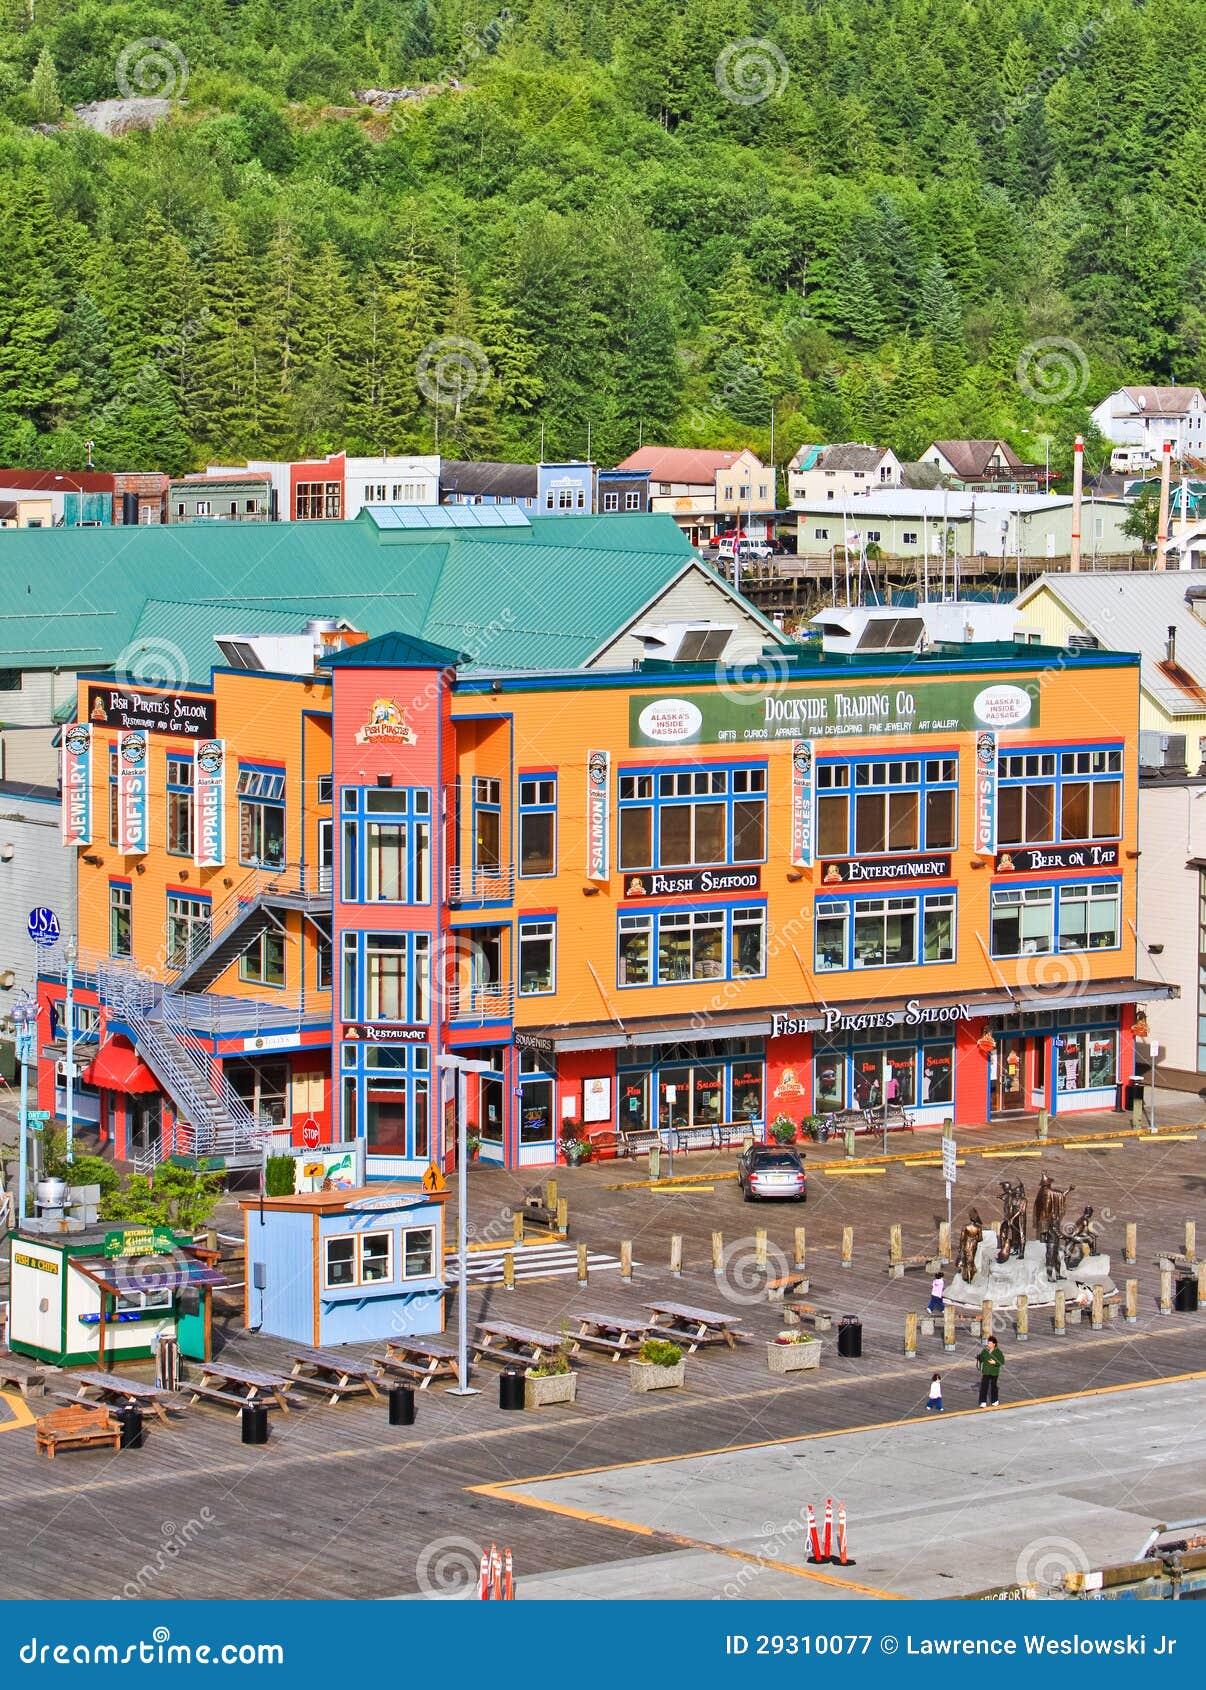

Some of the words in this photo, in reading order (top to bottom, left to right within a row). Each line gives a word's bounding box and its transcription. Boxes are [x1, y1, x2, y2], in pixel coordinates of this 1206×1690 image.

[110, 692, 128, 710] FISH
[131, 694, 170, 714] PIRATE'S
[174, 699, 207, 720] SALOON
[765, 697, 828, 721] DOCKSIDE
[835, 692, 889, 718] TRADING
[896, 690, 916, 715] CO.
[121, 713, 155, 729] RESTAURANT
[170, 718, 182, 731] GIFT
[185, 722, 199, 734] SHOP
[651, 713, 690, 721] ALASKA'S
[364, 724, 380, 737] FISH
[718, 730, 737, 739] GIFTS
[743, 729, 768, 738] CURIOS
[775, 727, 802, 736] APPAREL
[809, 726, 823, 735] FILM
[825, 724, 862, 734] DEVELOPING
[869, 723, 882, 732] FINE
[884, 721, 912, 731] JEWELRY
[918, 720, 930, 729] ART
[932, 719, 959, 729] GALLERY
[121, 768, 146, 776] Alaskan
[198, 778, 222, 786] Alaskan
[70, 761, 86, 836] JEWELRY
[589, 790, 606, 798] Smoked
[126, 778, 142, 844] GIFTS
[794, 795, 803, 848] TOTEM
[980, 780, 992, 843] GIFTS
[203, 787, 218, 857] APPAREL
[803, 799, 811, 849] POLES
[592, 801, 603, 869] SALMON
[1027, 851, 1067, 869] BEER
[1069, 852, 1085, 866] ON
[1091, 846, 1115, 865] TAP
[848, 862, 946, 880] ENTERTAINMENT
[650, 874, 693, 895] FRESH
[701, 871, 757, 891] SEAFOOD
[29, 907, 60, 934] USA
[771, 1012, 808, 1039] FISH
[821, 1008, 896, 1033] PIRATES
[905, 1000, 972, 1025] SALOON
[363, 1026, 426, 1041] RESTAURANT
[515, 1033, 552, 1050] SOUVENIRS
[926, 1057, 951, 1067] SALOON
[696, 1079, 722, 1091] SALOON
[303, 1127, 319, 1141] STOP
[15, 1253, 30, 1267] FISH
[31, 1258, 37, 1268] &
[37, 1260, 58, 1274] CHIPS
